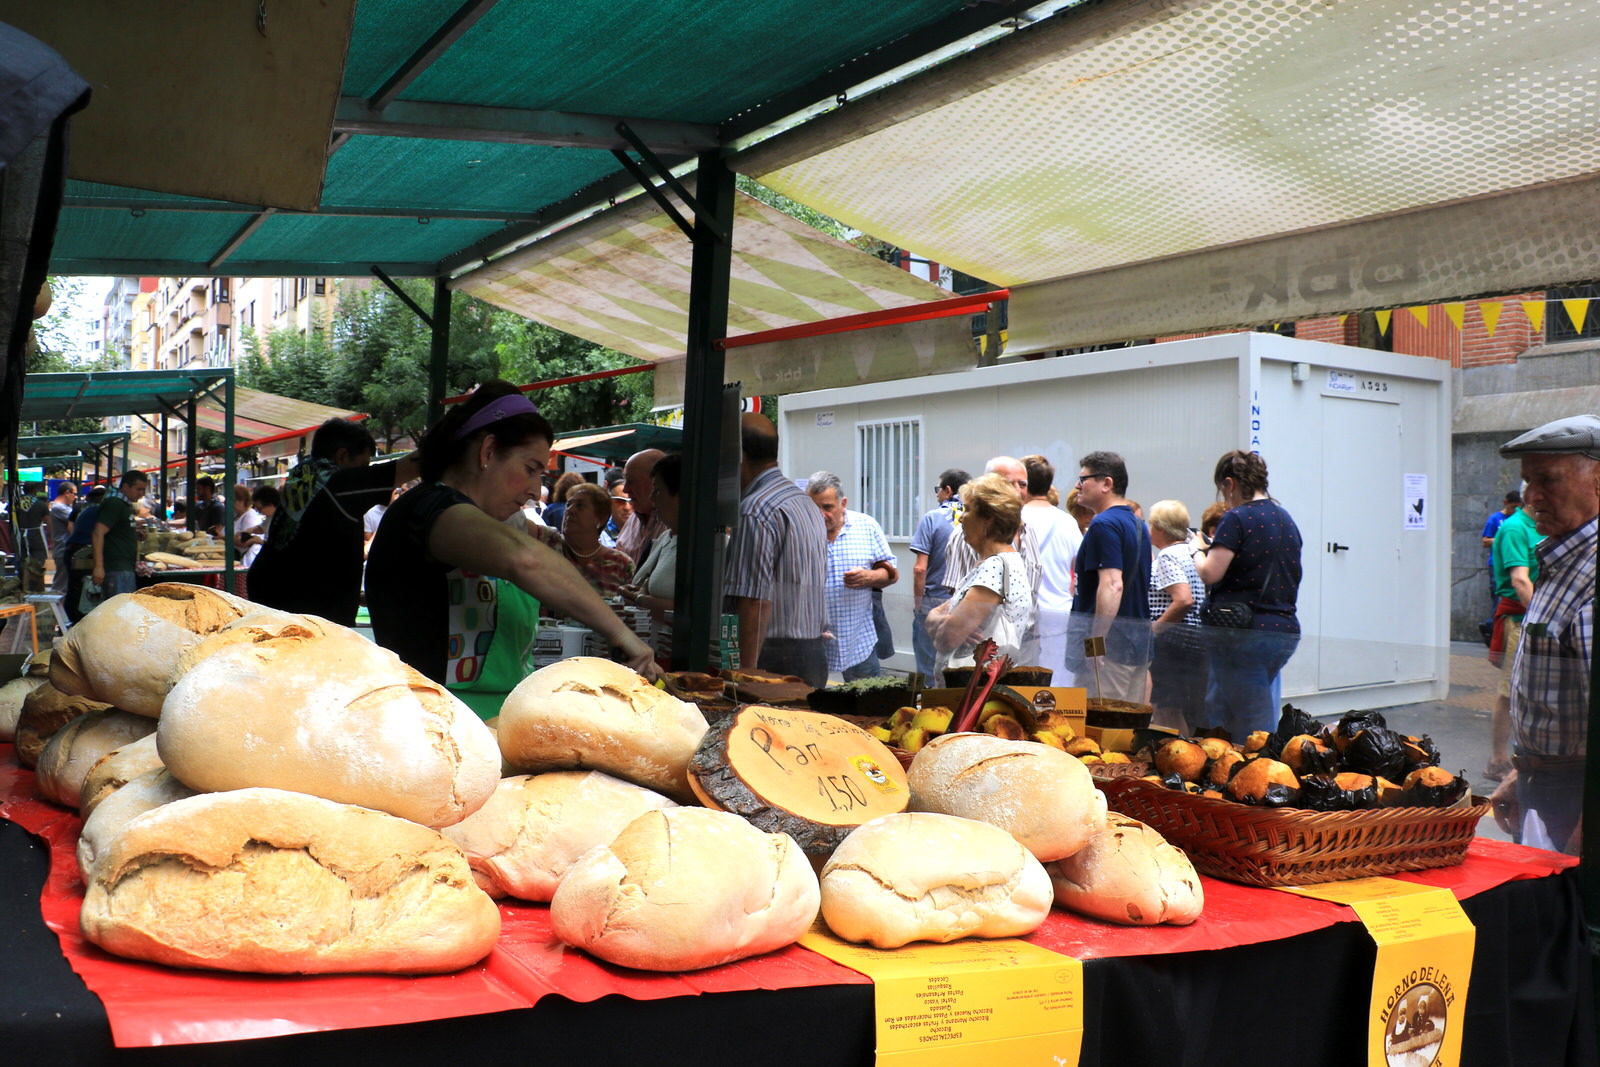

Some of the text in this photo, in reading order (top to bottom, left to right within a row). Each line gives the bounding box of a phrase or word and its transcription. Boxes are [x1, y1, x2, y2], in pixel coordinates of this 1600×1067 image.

[1251, 390, 1261, 456] INDA
[749, 727, 823, 776] Pan
[1380, 966, 1456, 1024] HORNO DE LEÑA
[919, 1032, 962, 1042] ESPECIALIDADES
